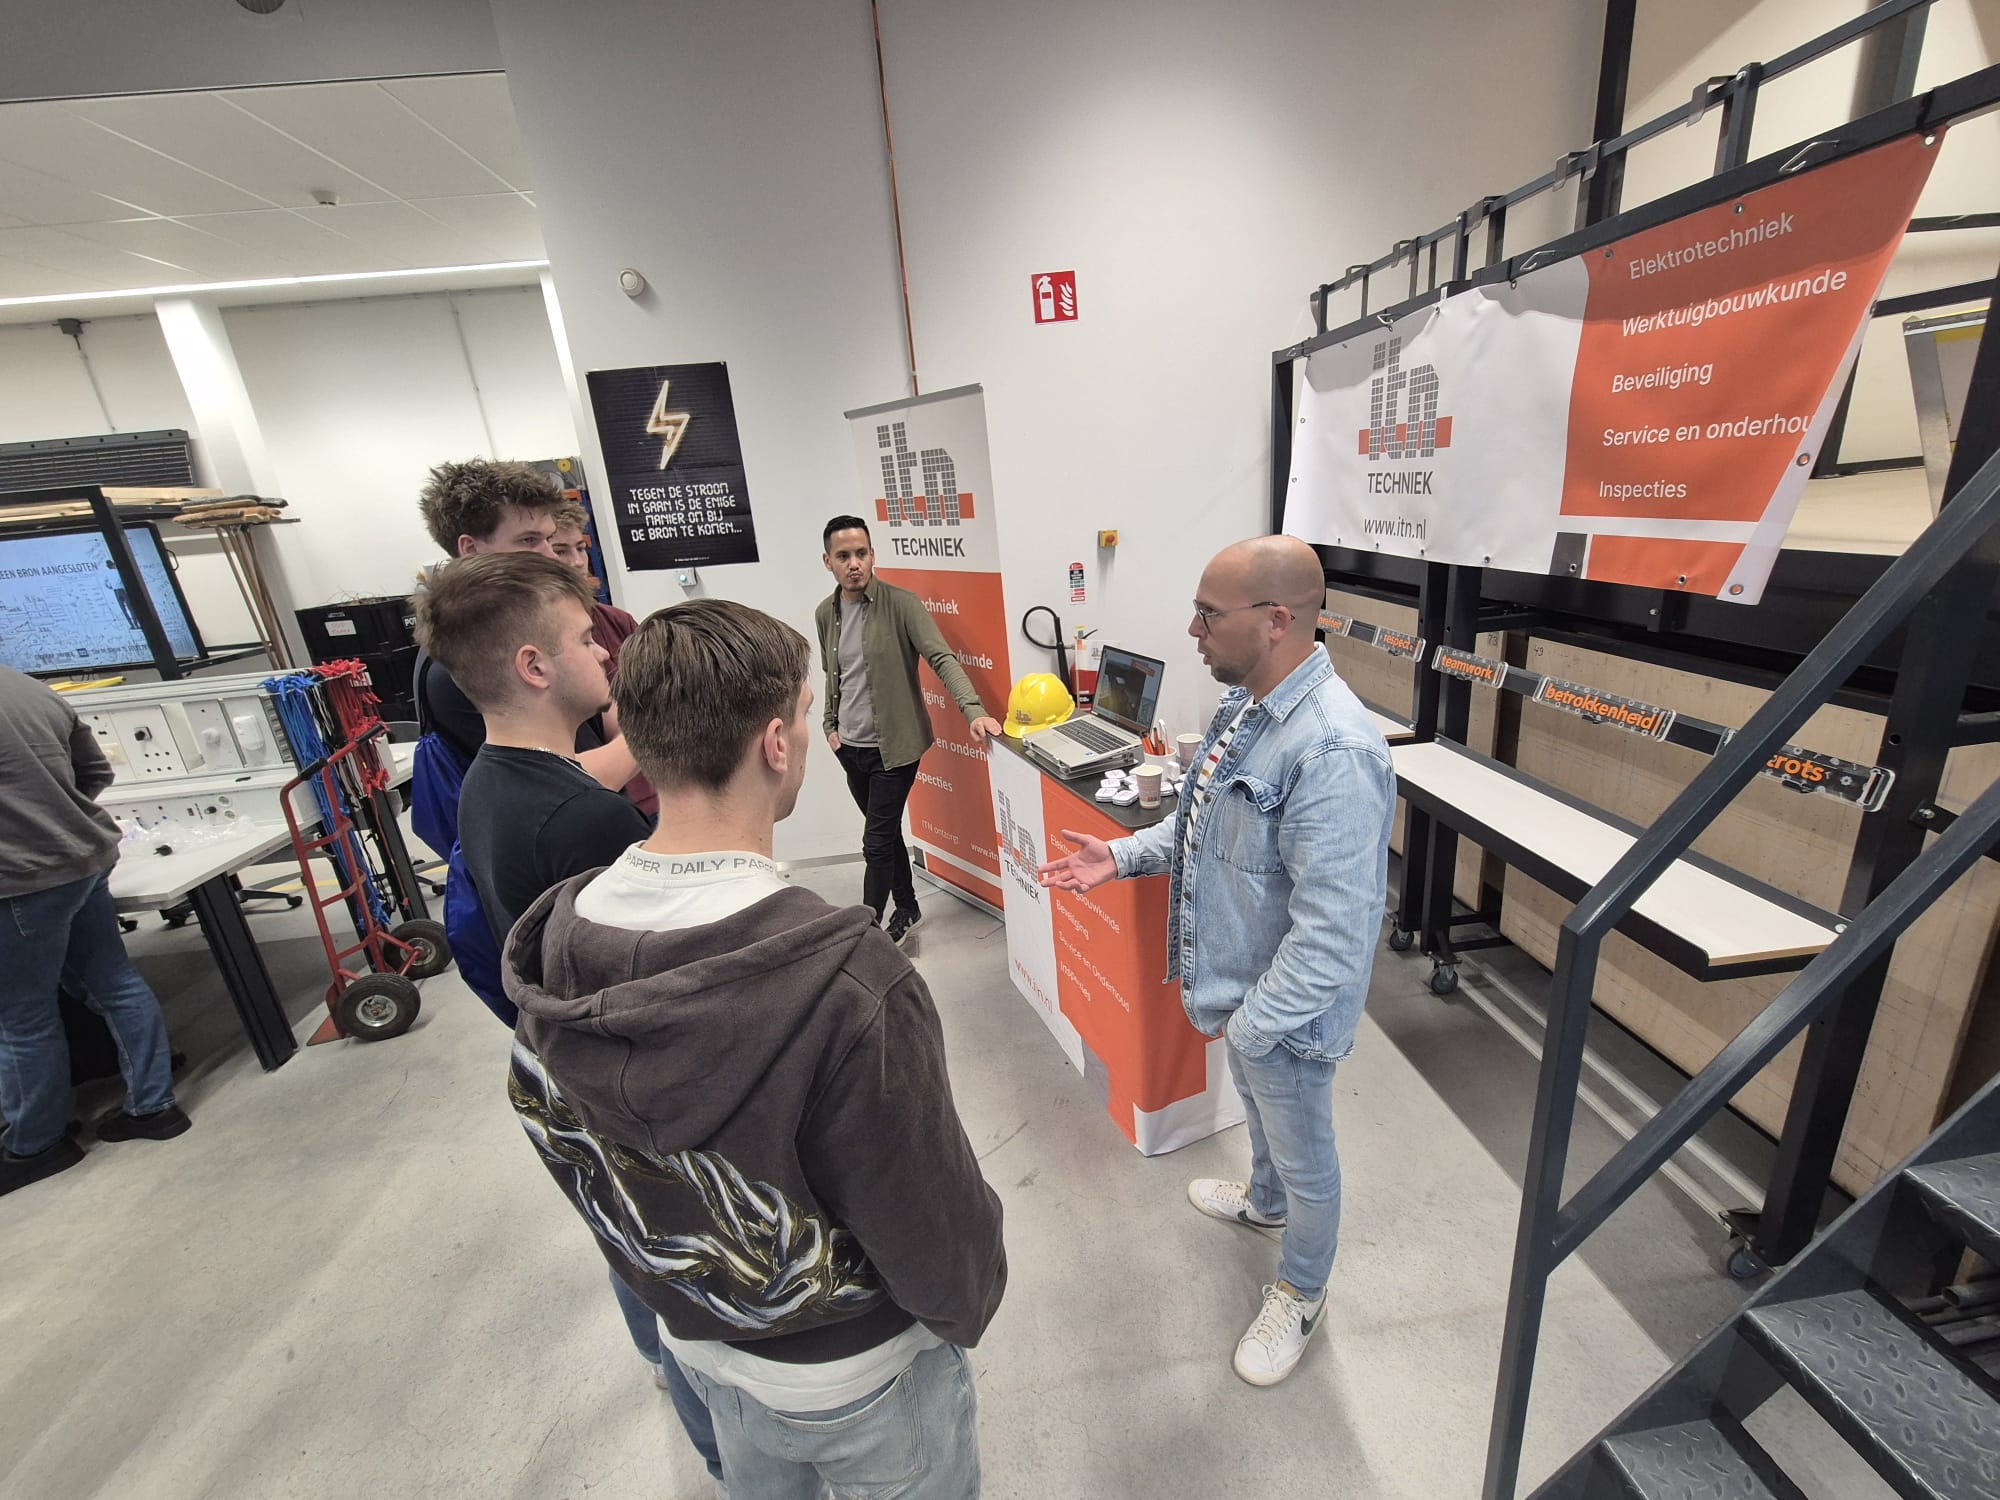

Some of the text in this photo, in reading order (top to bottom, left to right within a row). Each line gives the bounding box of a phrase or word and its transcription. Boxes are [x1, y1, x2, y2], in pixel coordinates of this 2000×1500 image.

[1629, 212, 1795, 281] Elektrotechniek
[1622, 269, 1847, 337] Werktuigbouwkunde
[1611, 363, 1713, 393] Beveiliging
[1602, 413, 1815, 447] Service en onderhou
[630, 482, 729, 501] TEGEN DE STROOM
[1367, 471, 1433, 495] TECHNIEK
[1599, 480, 1687, 501] Inspecties
[627, 495, 736, 515] IN GAAN IS DE ENIGE
[645, 510, 723, 527] MANIER OM BIJ
[1364, 516, 1426, 541] www.itn.nl
[631, 529, 645, 542] DE
[648, 526, 678, 540] BRON
[680, 525, 694, 537] TE
[891, 538, 965, 557] TECHNIEK
[0, 561, 98, 580] EEN BRON AANGESLOTEN
[1383, 634, 1411, 650] respect
[1487, 633, 1498, 647] 73
[1441, 655, 1493, 680] teamwork
[1545, 683, 1657, 731] betrokkenheid
[936, 737, 987, 762] en onderh
[915, 771, 953, 792] specties
[970, 842, 999, 863] www.itn
[625, 853, 660, 873] PAPER
[670, 858, 735, 875] DAILY
